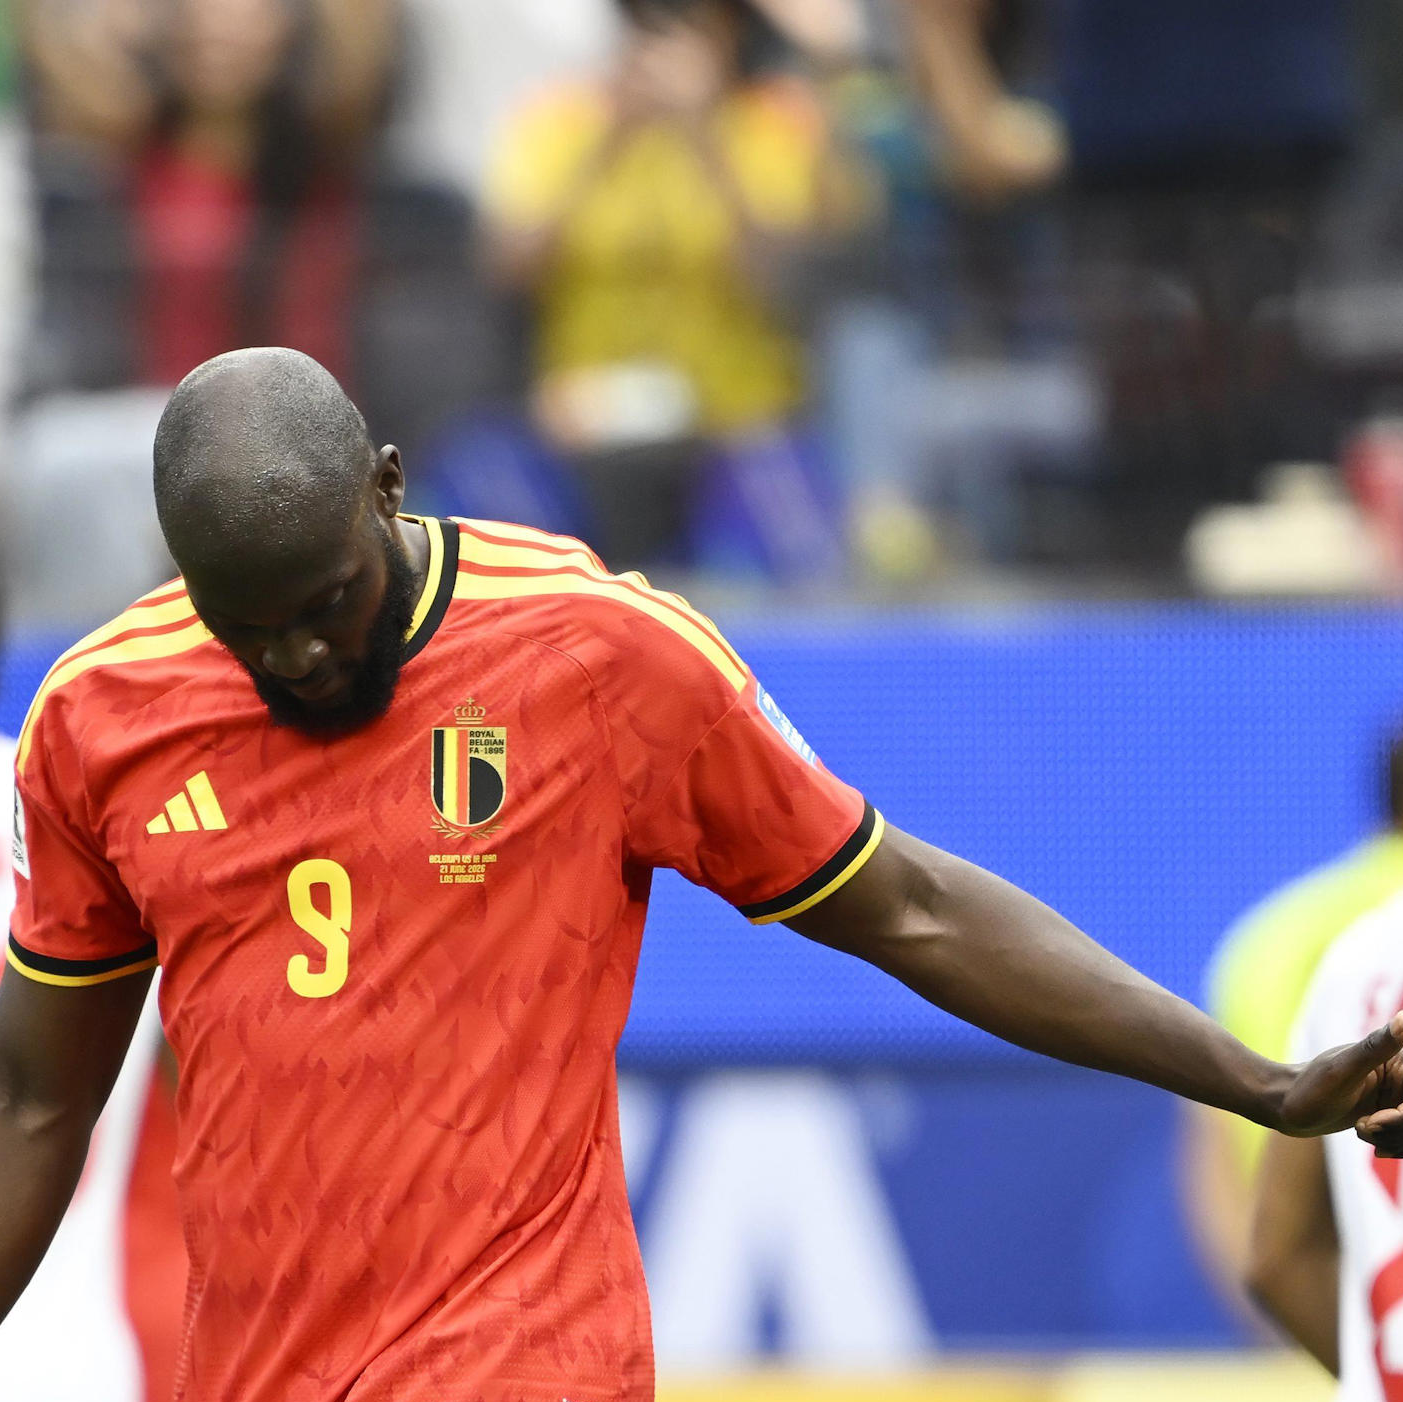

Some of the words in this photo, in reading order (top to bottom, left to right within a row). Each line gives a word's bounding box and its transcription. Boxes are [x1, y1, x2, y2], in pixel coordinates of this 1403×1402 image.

[469, 730, 495, 738] ROYAL
[469, 738, 504, 746] BELGIAN
[439, 865, 448, 873] 21
[468, 865, 486, 873] 2026
[439, 875, 453, 883] LOS
[454, 874, 485, 883] ANGELES
[285, 857, 354, 999] 9
